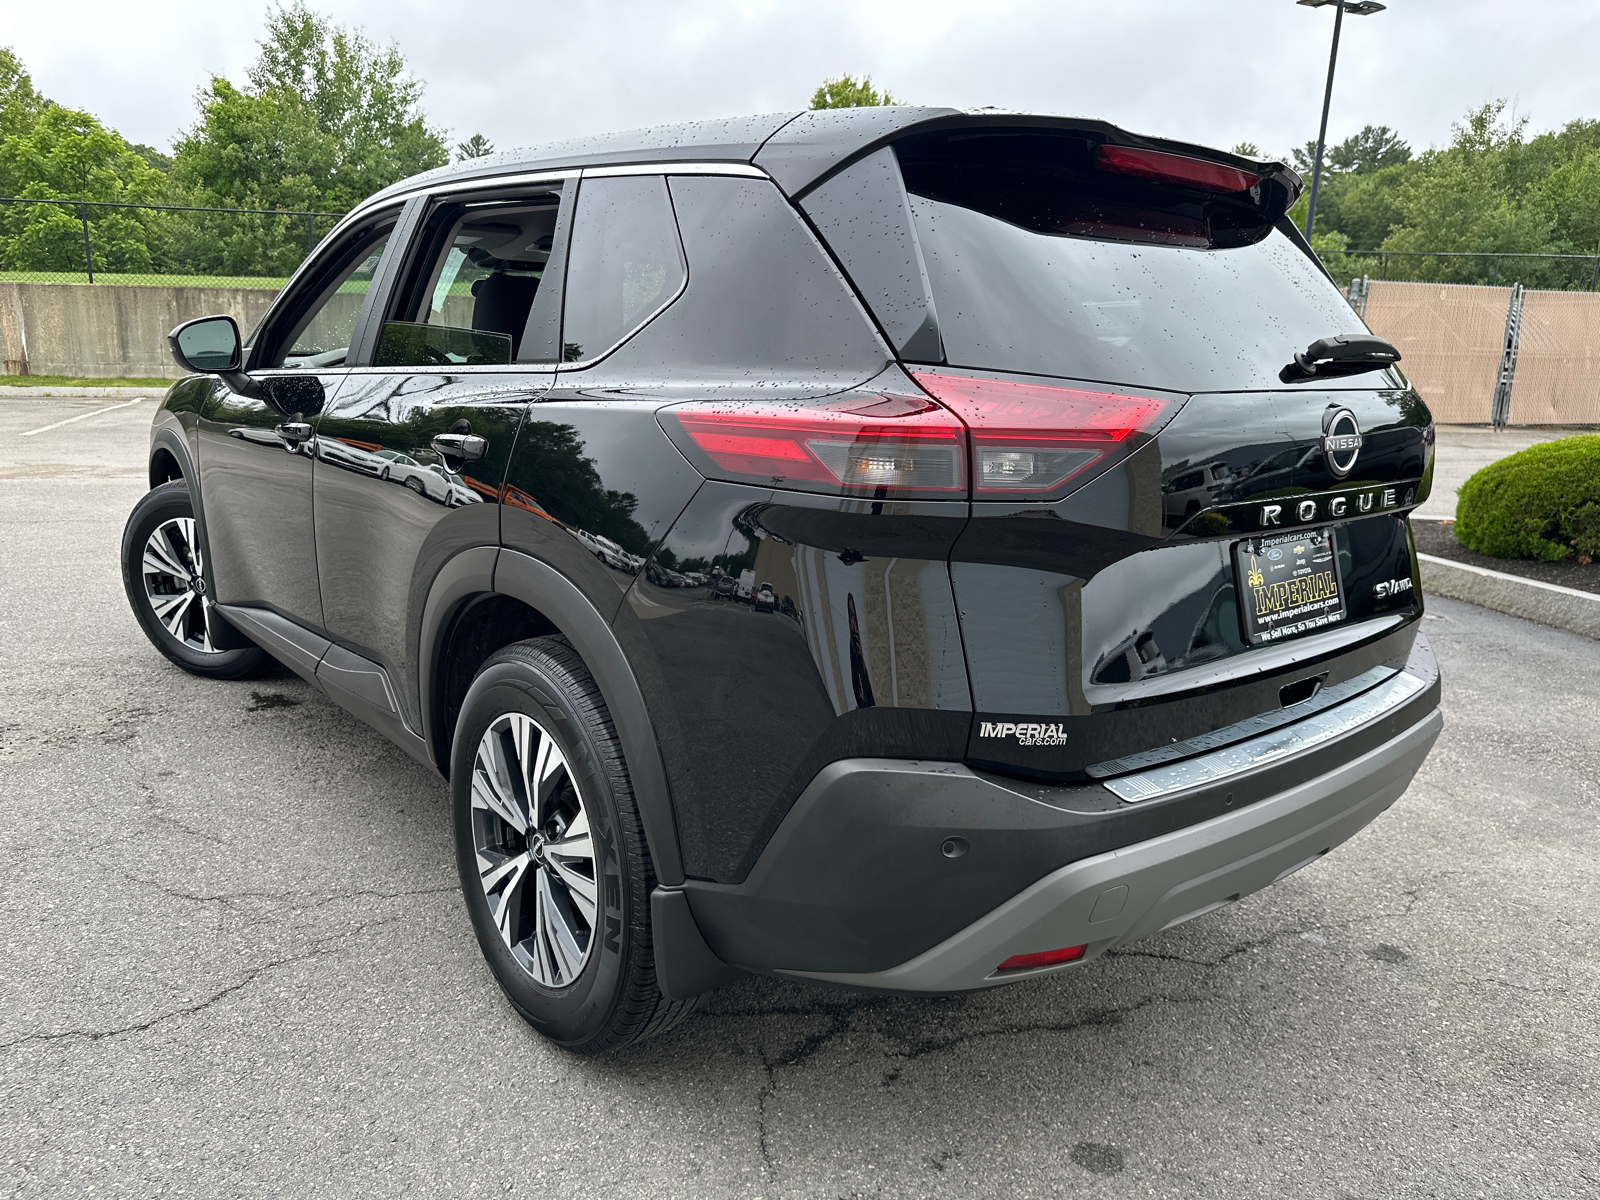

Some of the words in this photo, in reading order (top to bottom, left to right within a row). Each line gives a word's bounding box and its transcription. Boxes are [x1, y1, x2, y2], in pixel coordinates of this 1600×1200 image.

[1260, 489, 1397, 526] ROGUE
[1261, 531, 1317, 548] Imperialcars.com
[1297, 567, 1312, 575] TOYOTA
[1254, 571, 1338, 615] IMPERIAL
[1257, 597, 1339, 625] www.imperialcars.com
[1261, 630, 1270, 641] We
[1272, 628, 1282, 639] Sell
[1282, 624, 1298, 636] More,
[1298, 622, 1305, 632] So
[1305, 620, 1316, 630] You
[1316, 616, 1328, 626] Save
[1328, 613, 1341, 623] More
[979, 721, 1068, 738] IMPERIAL
[1018, 737, 1067, 746] cars.com
[572, 740, 621, 955] NEXEN
